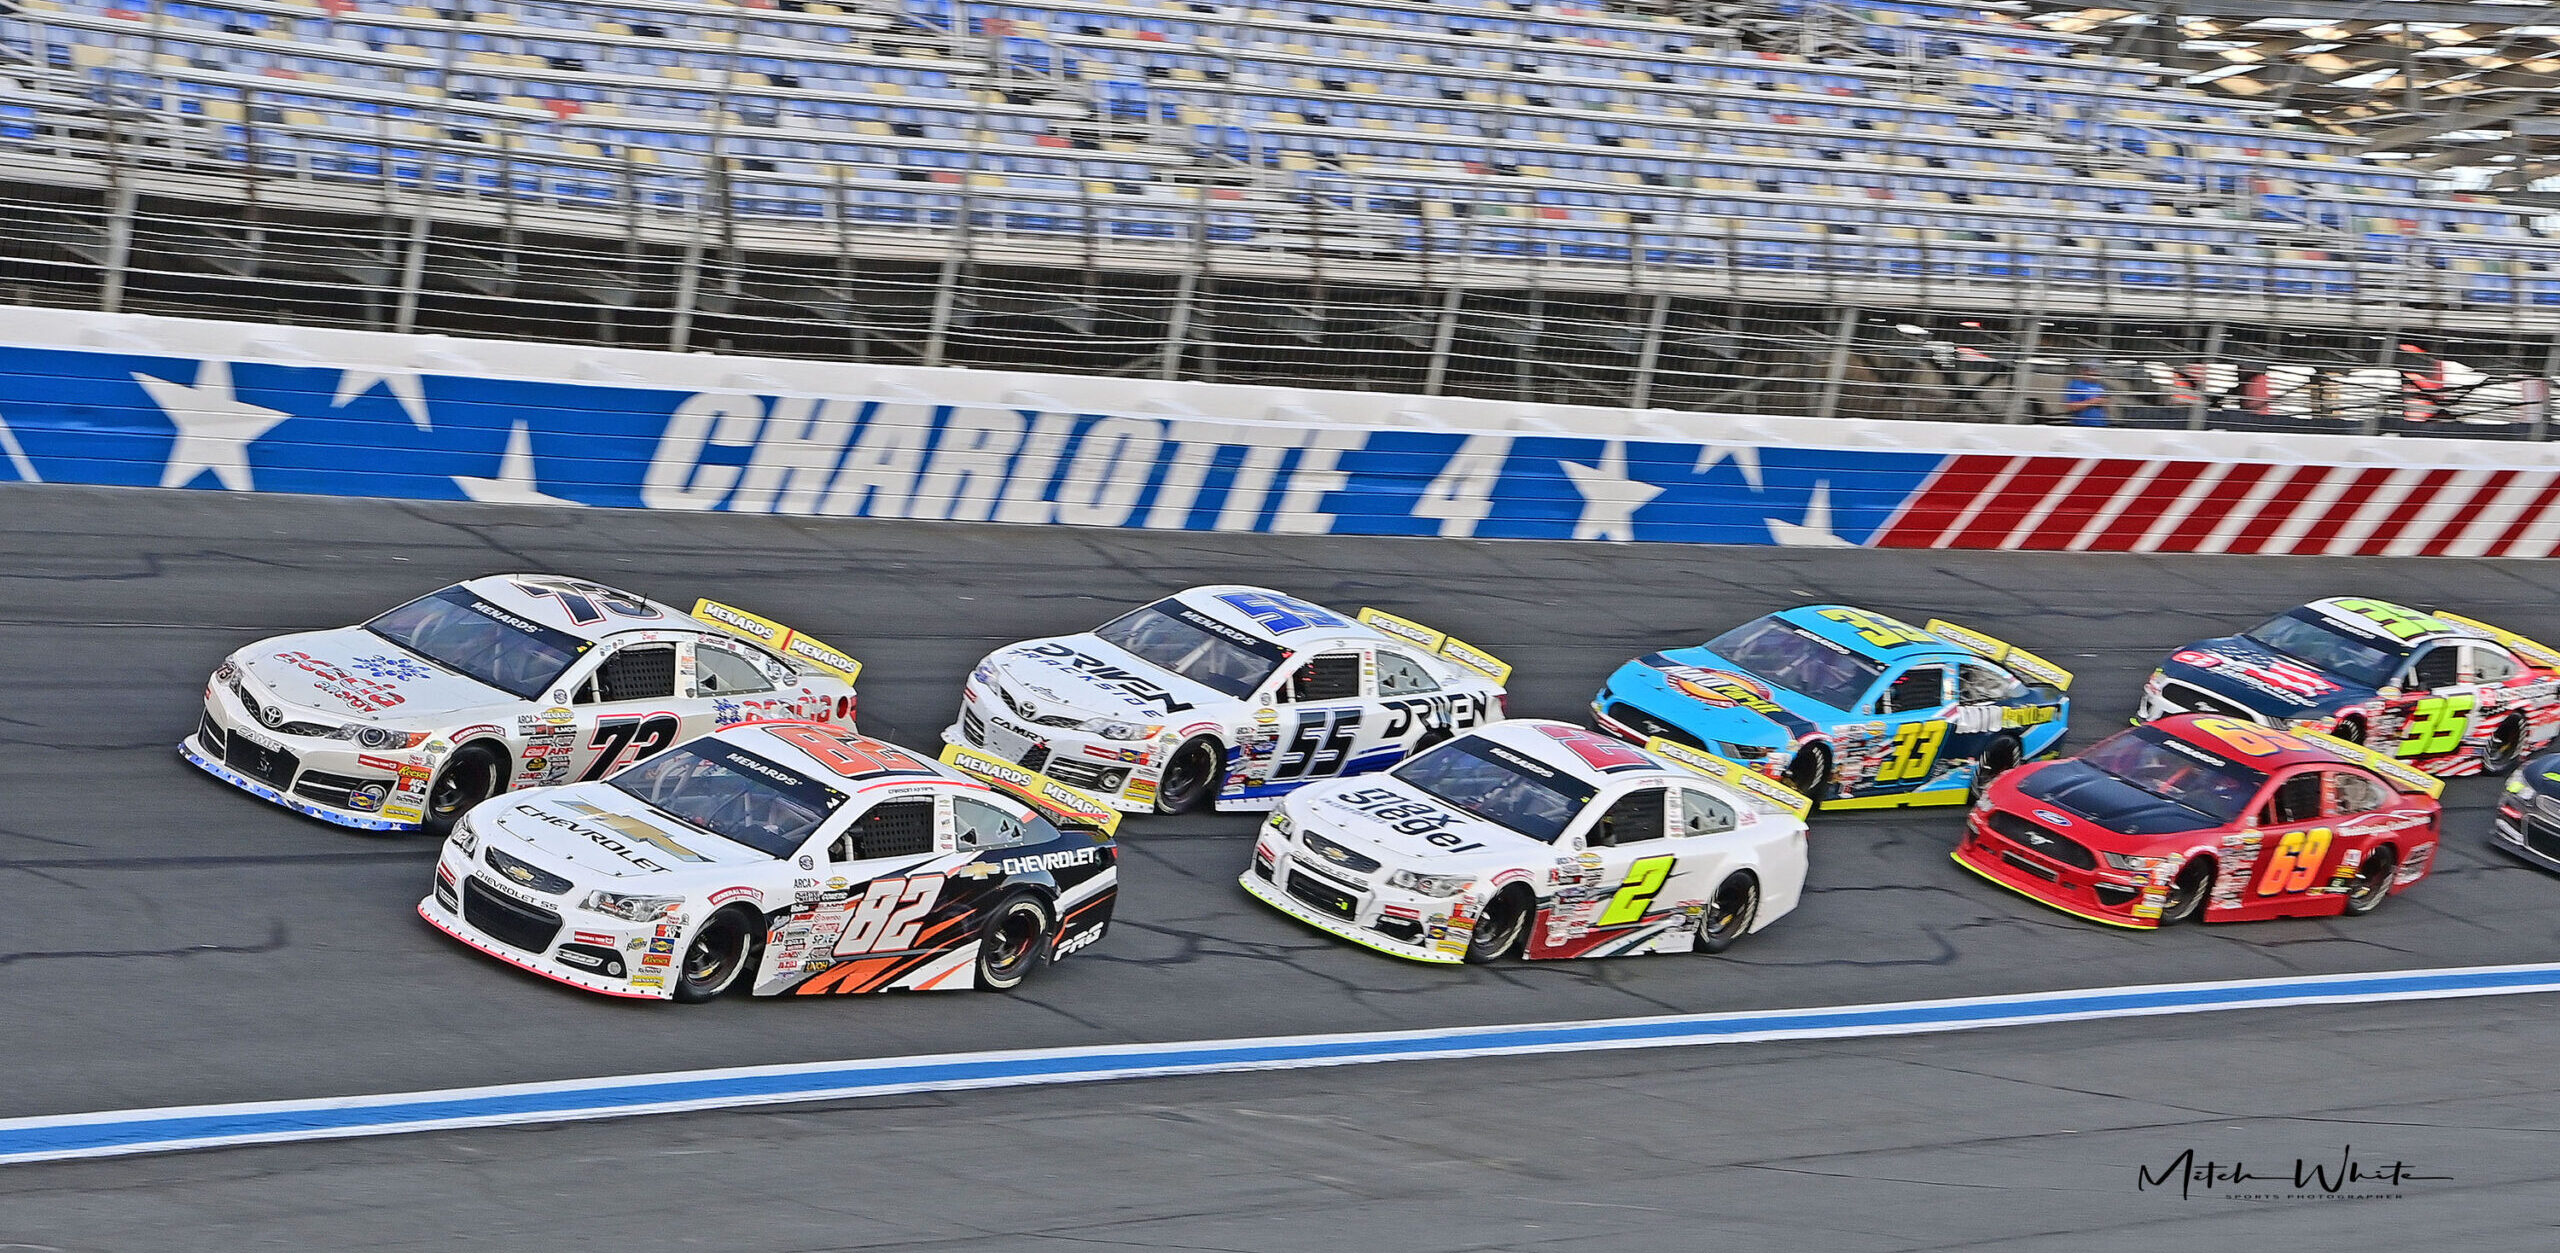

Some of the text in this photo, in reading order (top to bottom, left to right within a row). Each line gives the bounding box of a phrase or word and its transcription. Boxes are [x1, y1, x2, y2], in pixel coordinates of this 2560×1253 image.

[639, 392, 1515, 538] CHARLOTTE 4
[471, 601, 540, 634] MENARDS
[703, 602, 775, 641] MENARDS
[1179, 610, 1260, 646] MENARDS
[273, 651, 405, 708] acacia
[789, 640, 858, 674] MENARDS
[1018, 643, 1196, 713] DRIVEN
[314, 680, 382, 714] energy
[1008, 650, 1165, 719] TRACKSIDE
[991, 716, 1051, 743] CAMRY
[1380, 690, 1488, 739] DRIVEN
[2394, 692, 2476, 758] 35
[236, 724, 296, 752] CAMRY
[578, 711, 681, 783] 73
[1270, 705, 1367, 782] 55
[1874, 720, 1949, 786] 33
[726, 752, 803, 786] MENARDS
[954, 753, 1033, 787] MENARDS
[1044, 781, 1112, 825] MENARDS
[1338, 793, 1488, 853] siegel
[1355, 788, 1467, 828] max
[515, 805, 673, 873] CHEVROLET
[1003, 847, 1096, 877] CHEVROLET
[2257, 826, 2333, 897] 69
[475, 869, 538, 904] CHEVROLET
[540, 900, 559, 911] SS
[793, 878, 812, 889] ARCA
[1597, 854, 1679, 927] 2
[832, 872, 946, 957] 82
